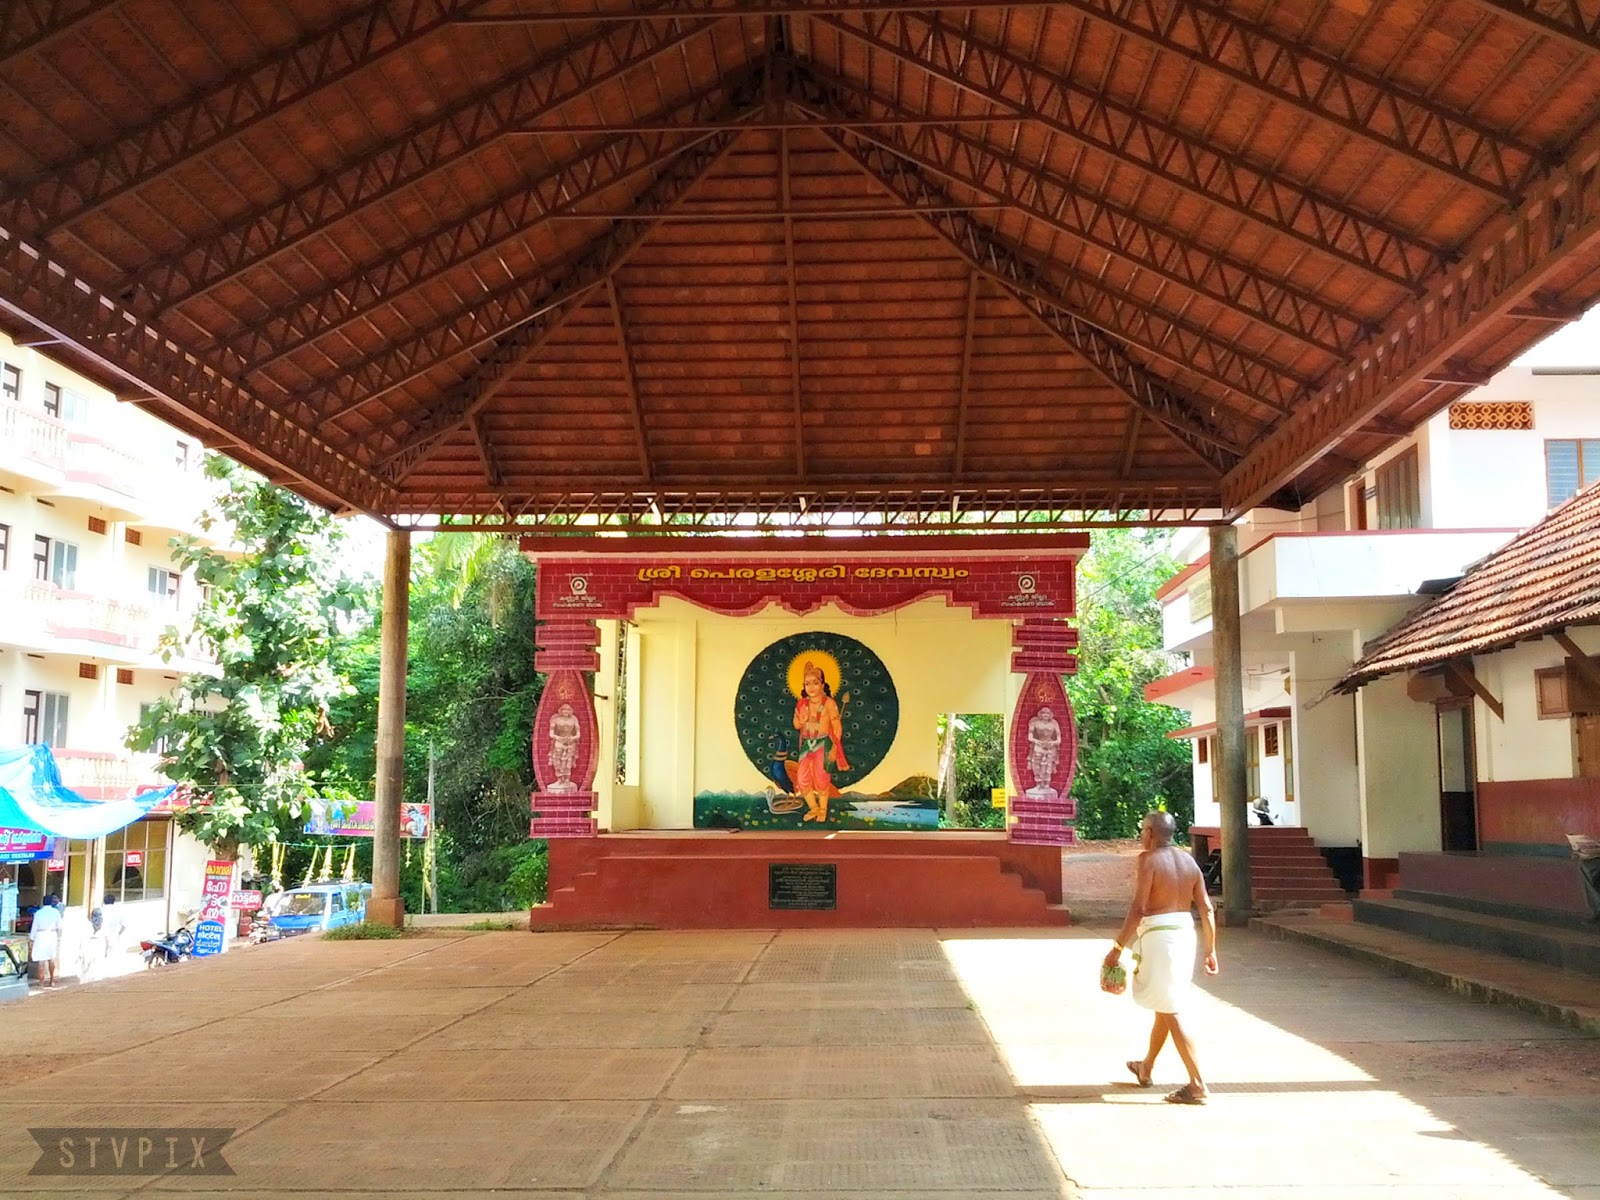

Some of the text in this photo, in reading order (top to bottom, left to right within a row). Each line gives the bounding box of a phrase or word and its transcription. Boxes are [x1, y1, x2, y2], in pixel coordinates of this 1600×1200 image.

[638, 565, 970, 582] ശ്രീ പെരളശ്ശേരി ദേവസ്വം
